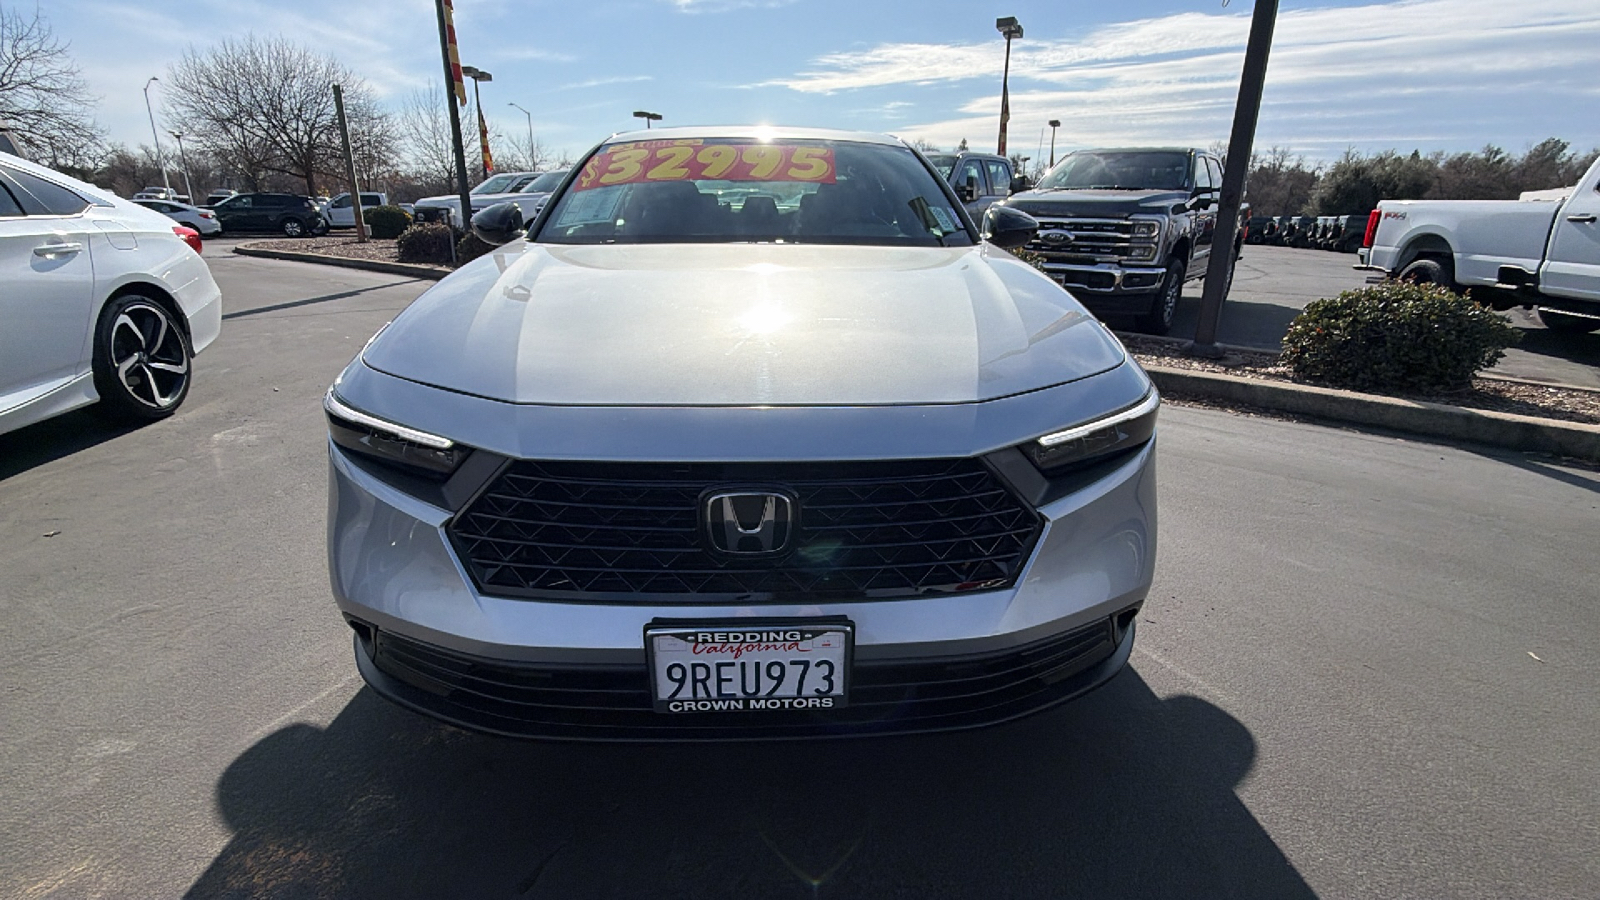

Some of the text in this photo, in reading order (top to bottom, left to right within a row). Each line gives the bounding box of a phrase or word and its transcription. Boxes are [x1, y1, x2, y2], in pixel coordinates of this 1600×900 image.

[697, 631, 800, 642] REDDING
[692, 641, 812, 659] California
[666, 660, 834, 698] 9REU973
[668, 698, 834, 712] CROWN MOTORS
